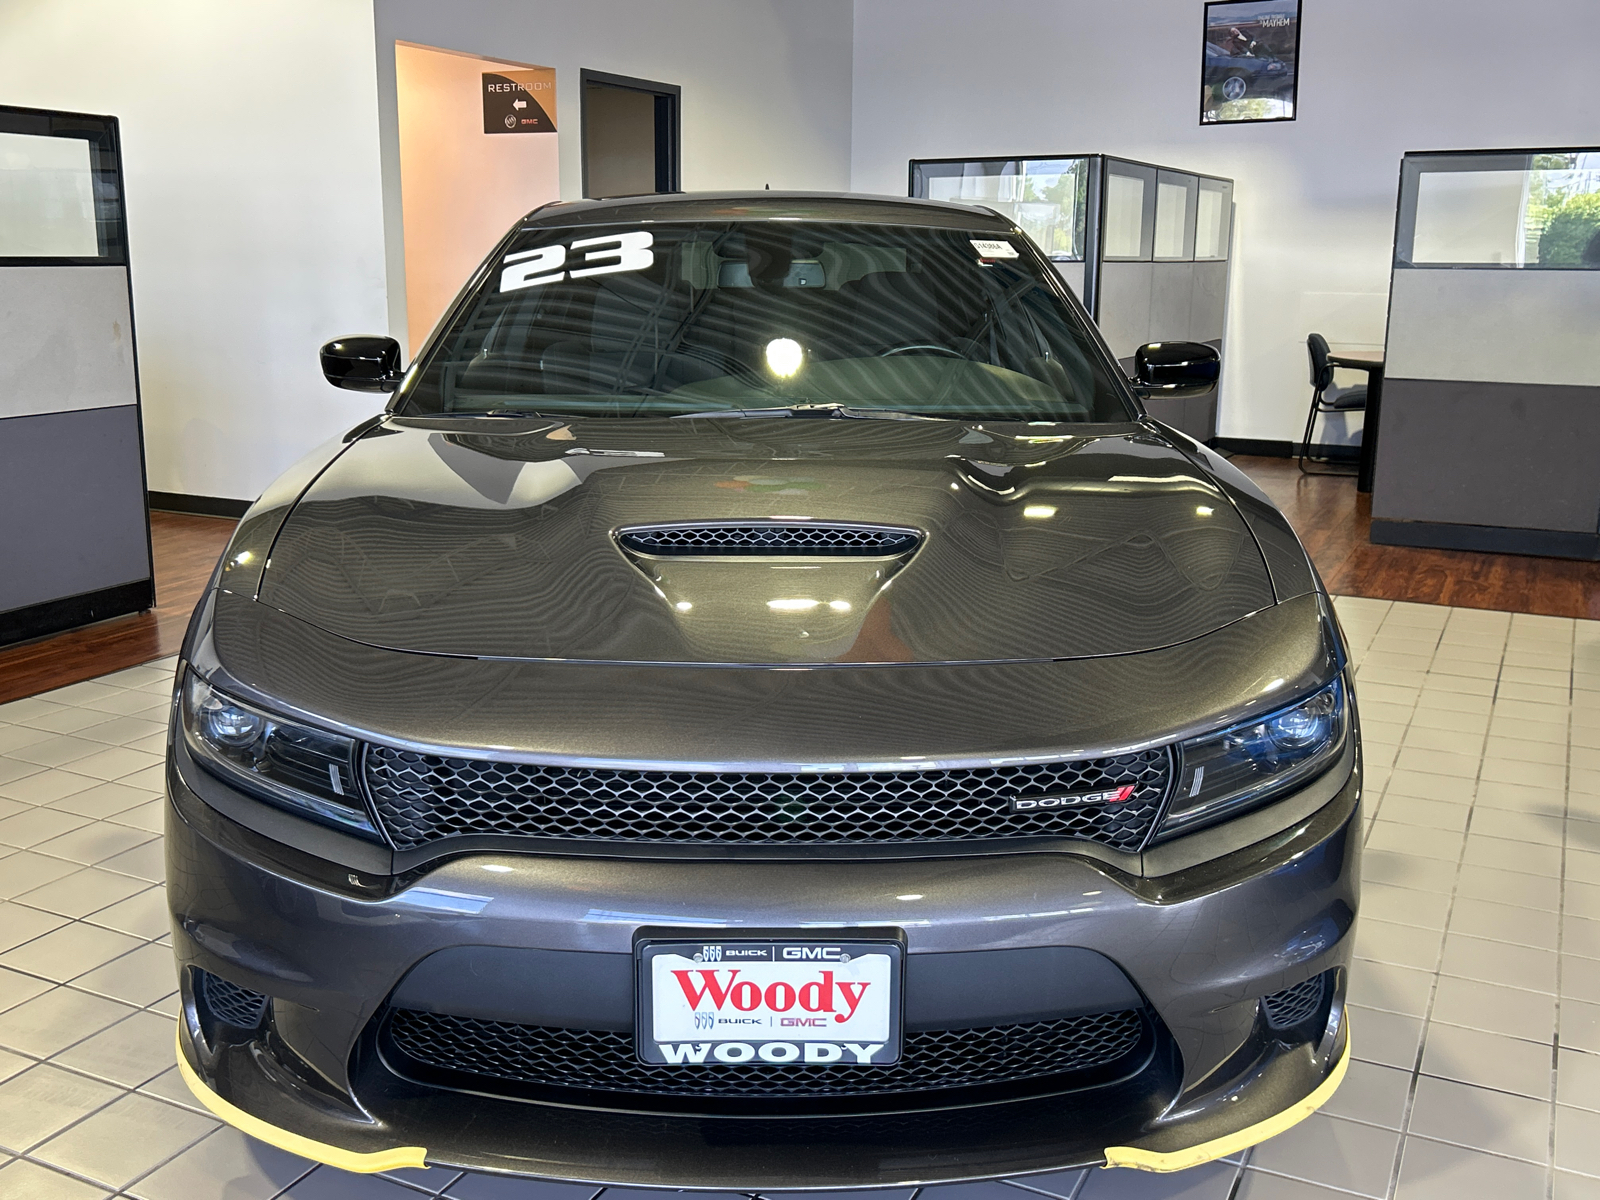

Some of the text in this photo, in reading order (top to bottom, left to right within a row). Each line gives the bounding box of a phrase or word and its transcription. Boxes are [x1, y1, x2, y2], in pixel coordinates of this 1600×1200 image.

[1262, 18, 1290, 28] MAYHEM
[487, 82, 552, 92] RESTROOM
[500, 231, 654, 293] 23
[1016, 790, 1121, 809] DODGE
[725, 947, 842, 959] BUICK GMC
[671, 969, 871, 1024] Woody
[780, 1017, 828, 1028] GMC
[658, 1042, 884, 1064] WOODY
